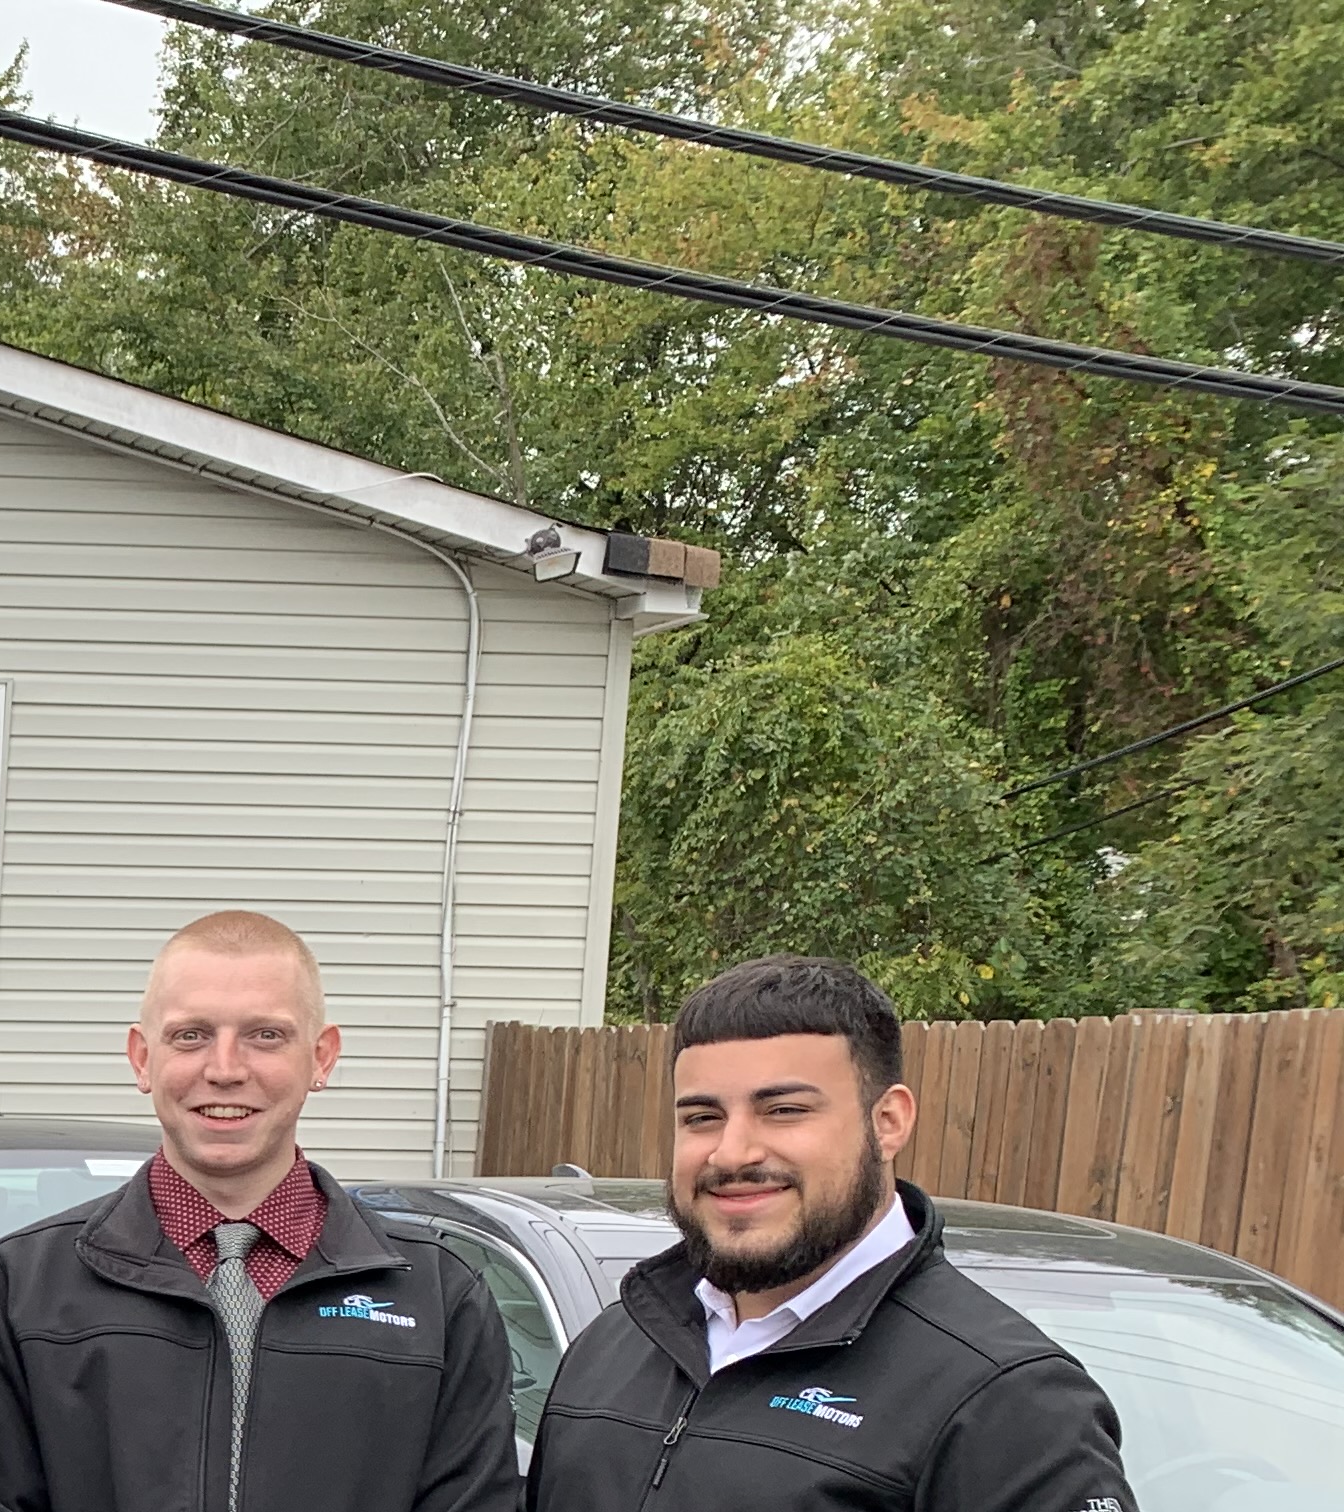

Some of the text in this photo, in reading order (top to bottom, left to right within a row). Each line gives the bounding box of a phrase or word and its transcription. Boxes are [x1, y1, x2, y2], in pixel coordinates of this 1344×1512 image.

[319, 1306, 416, 1328] OFF LEASE MOTORS
[769, 1396, 864, 1428] OFF LEASE MOTORS
[1086, 1498, 1115, 1510] THE
